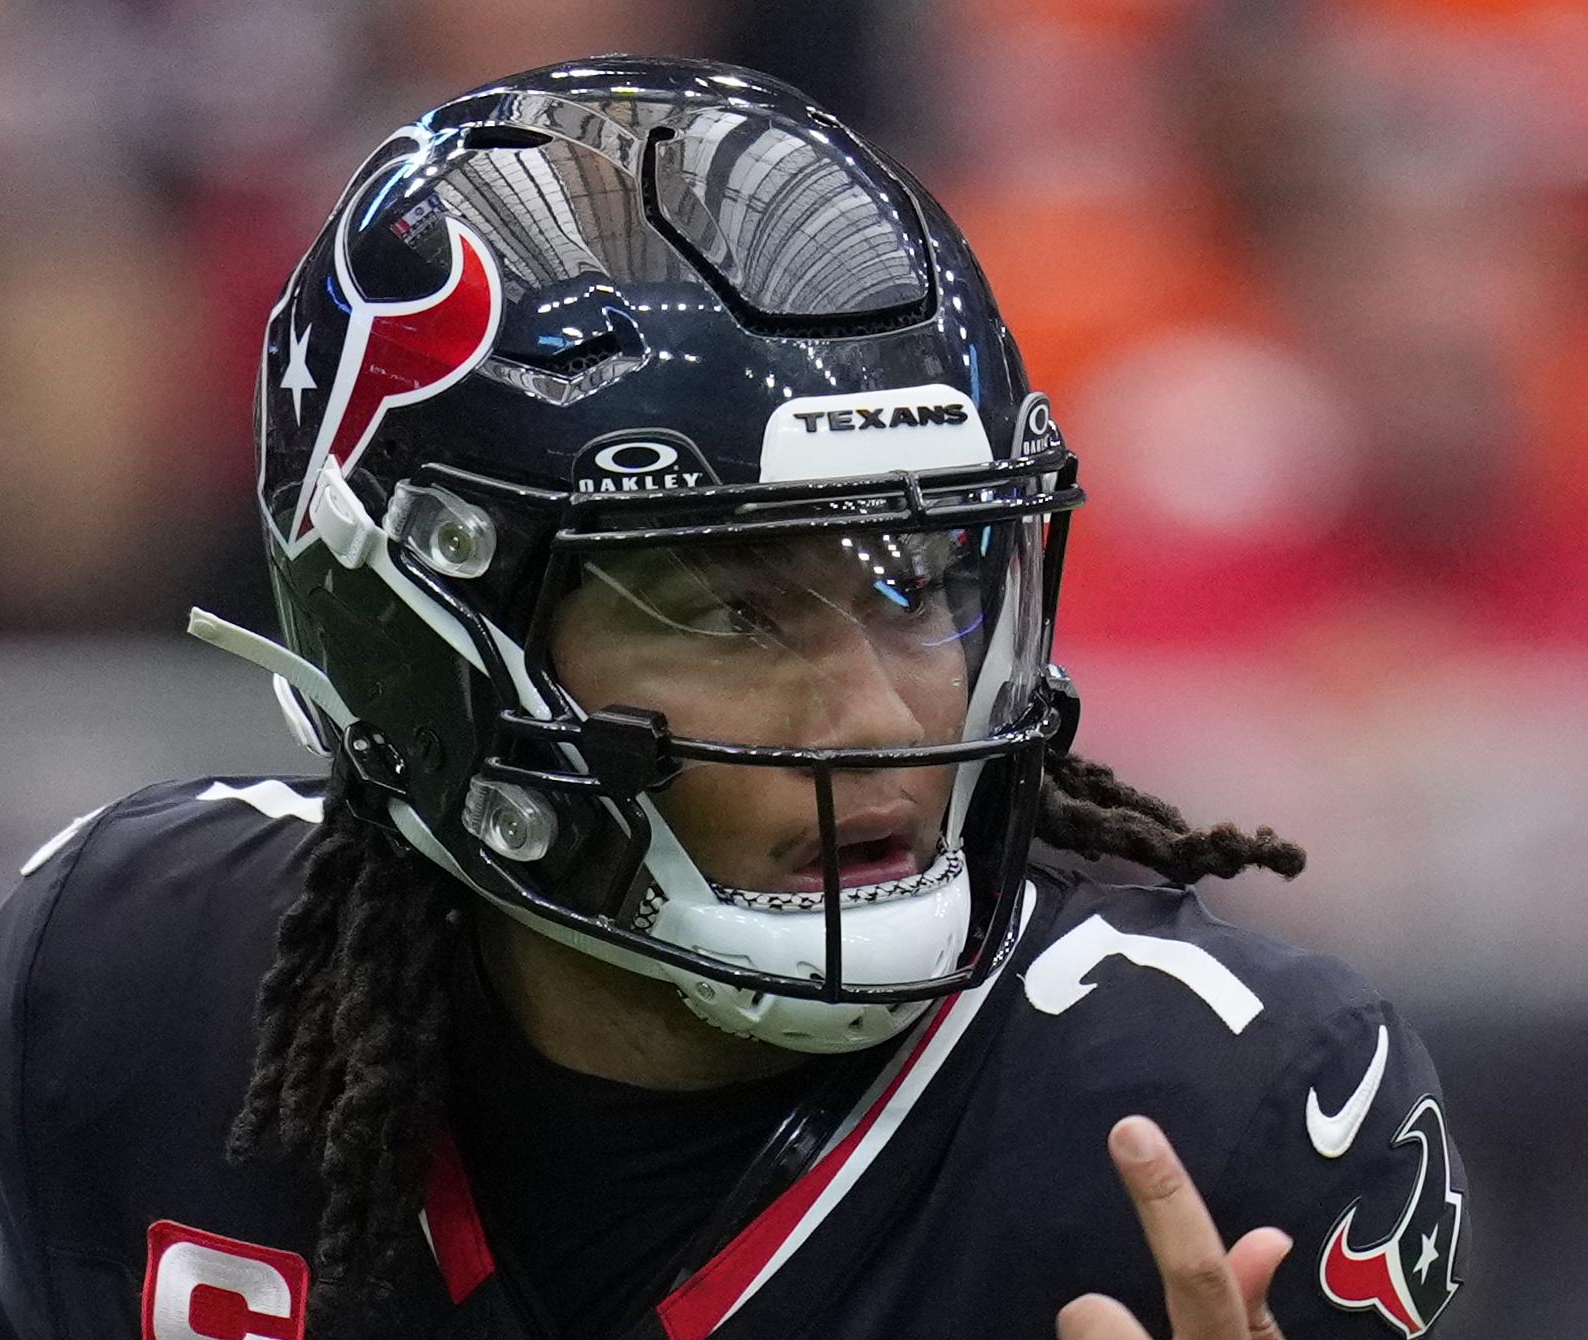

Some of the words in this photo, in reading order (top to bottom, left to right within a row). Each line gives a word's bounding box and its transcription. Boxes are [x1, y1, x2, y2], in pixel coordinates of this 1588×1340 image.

[794, 404, 968, 433] TEXANS
[579, 473, 699, 492] OAKLEY
[1025, 915, 1265, 1034] 7
